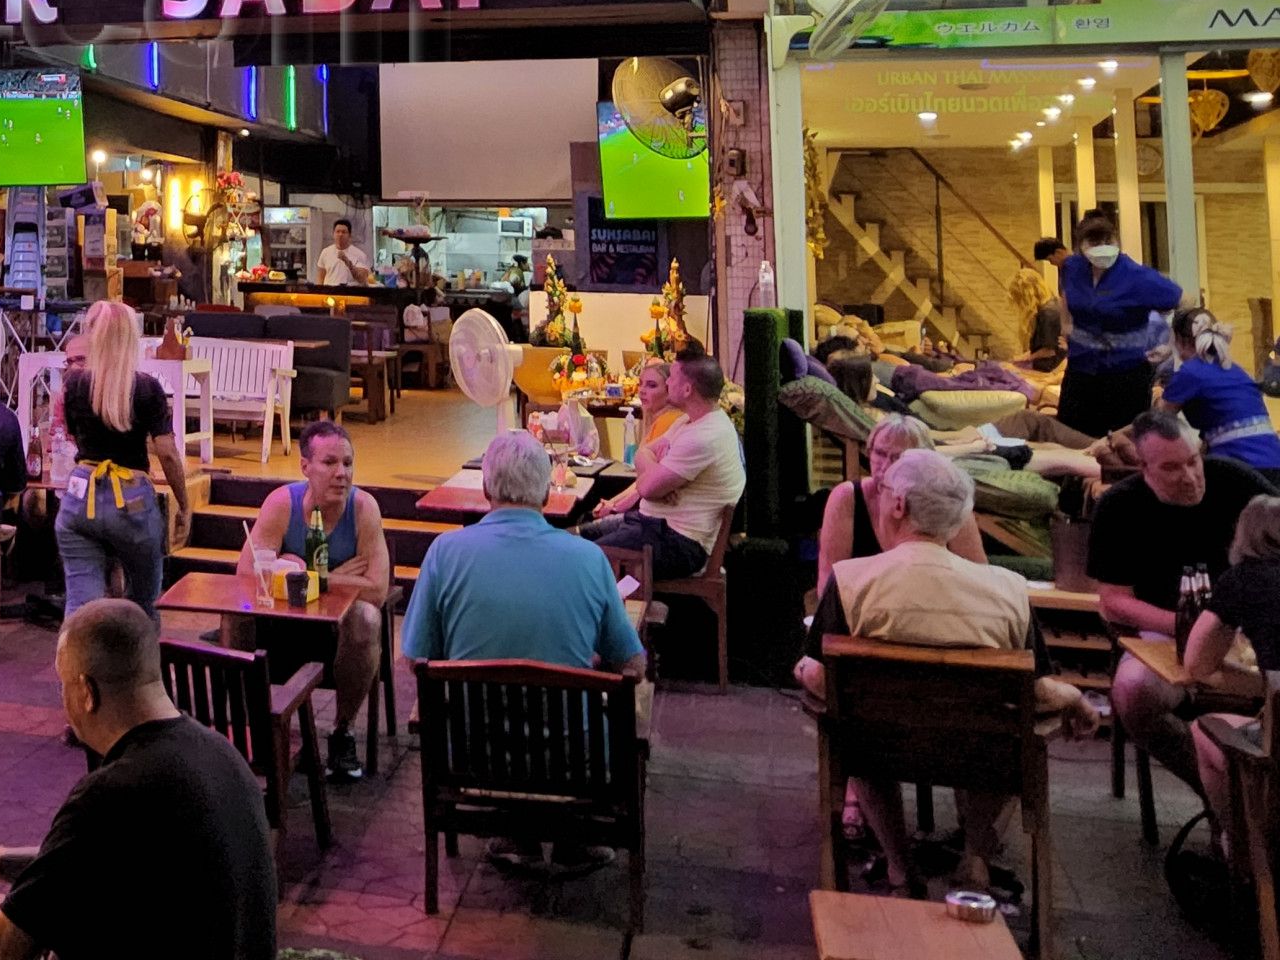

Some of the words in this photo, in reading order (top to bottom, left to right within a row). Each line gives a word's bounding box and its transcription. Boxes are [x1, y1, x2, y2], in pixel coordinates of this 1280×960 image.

[937, 19, 1040, 33] ウエルカム
[877, 71, 938, 86] URBAN
[943, 69, 985, 85] THAI
[592, 243, 607, 253] BAR
